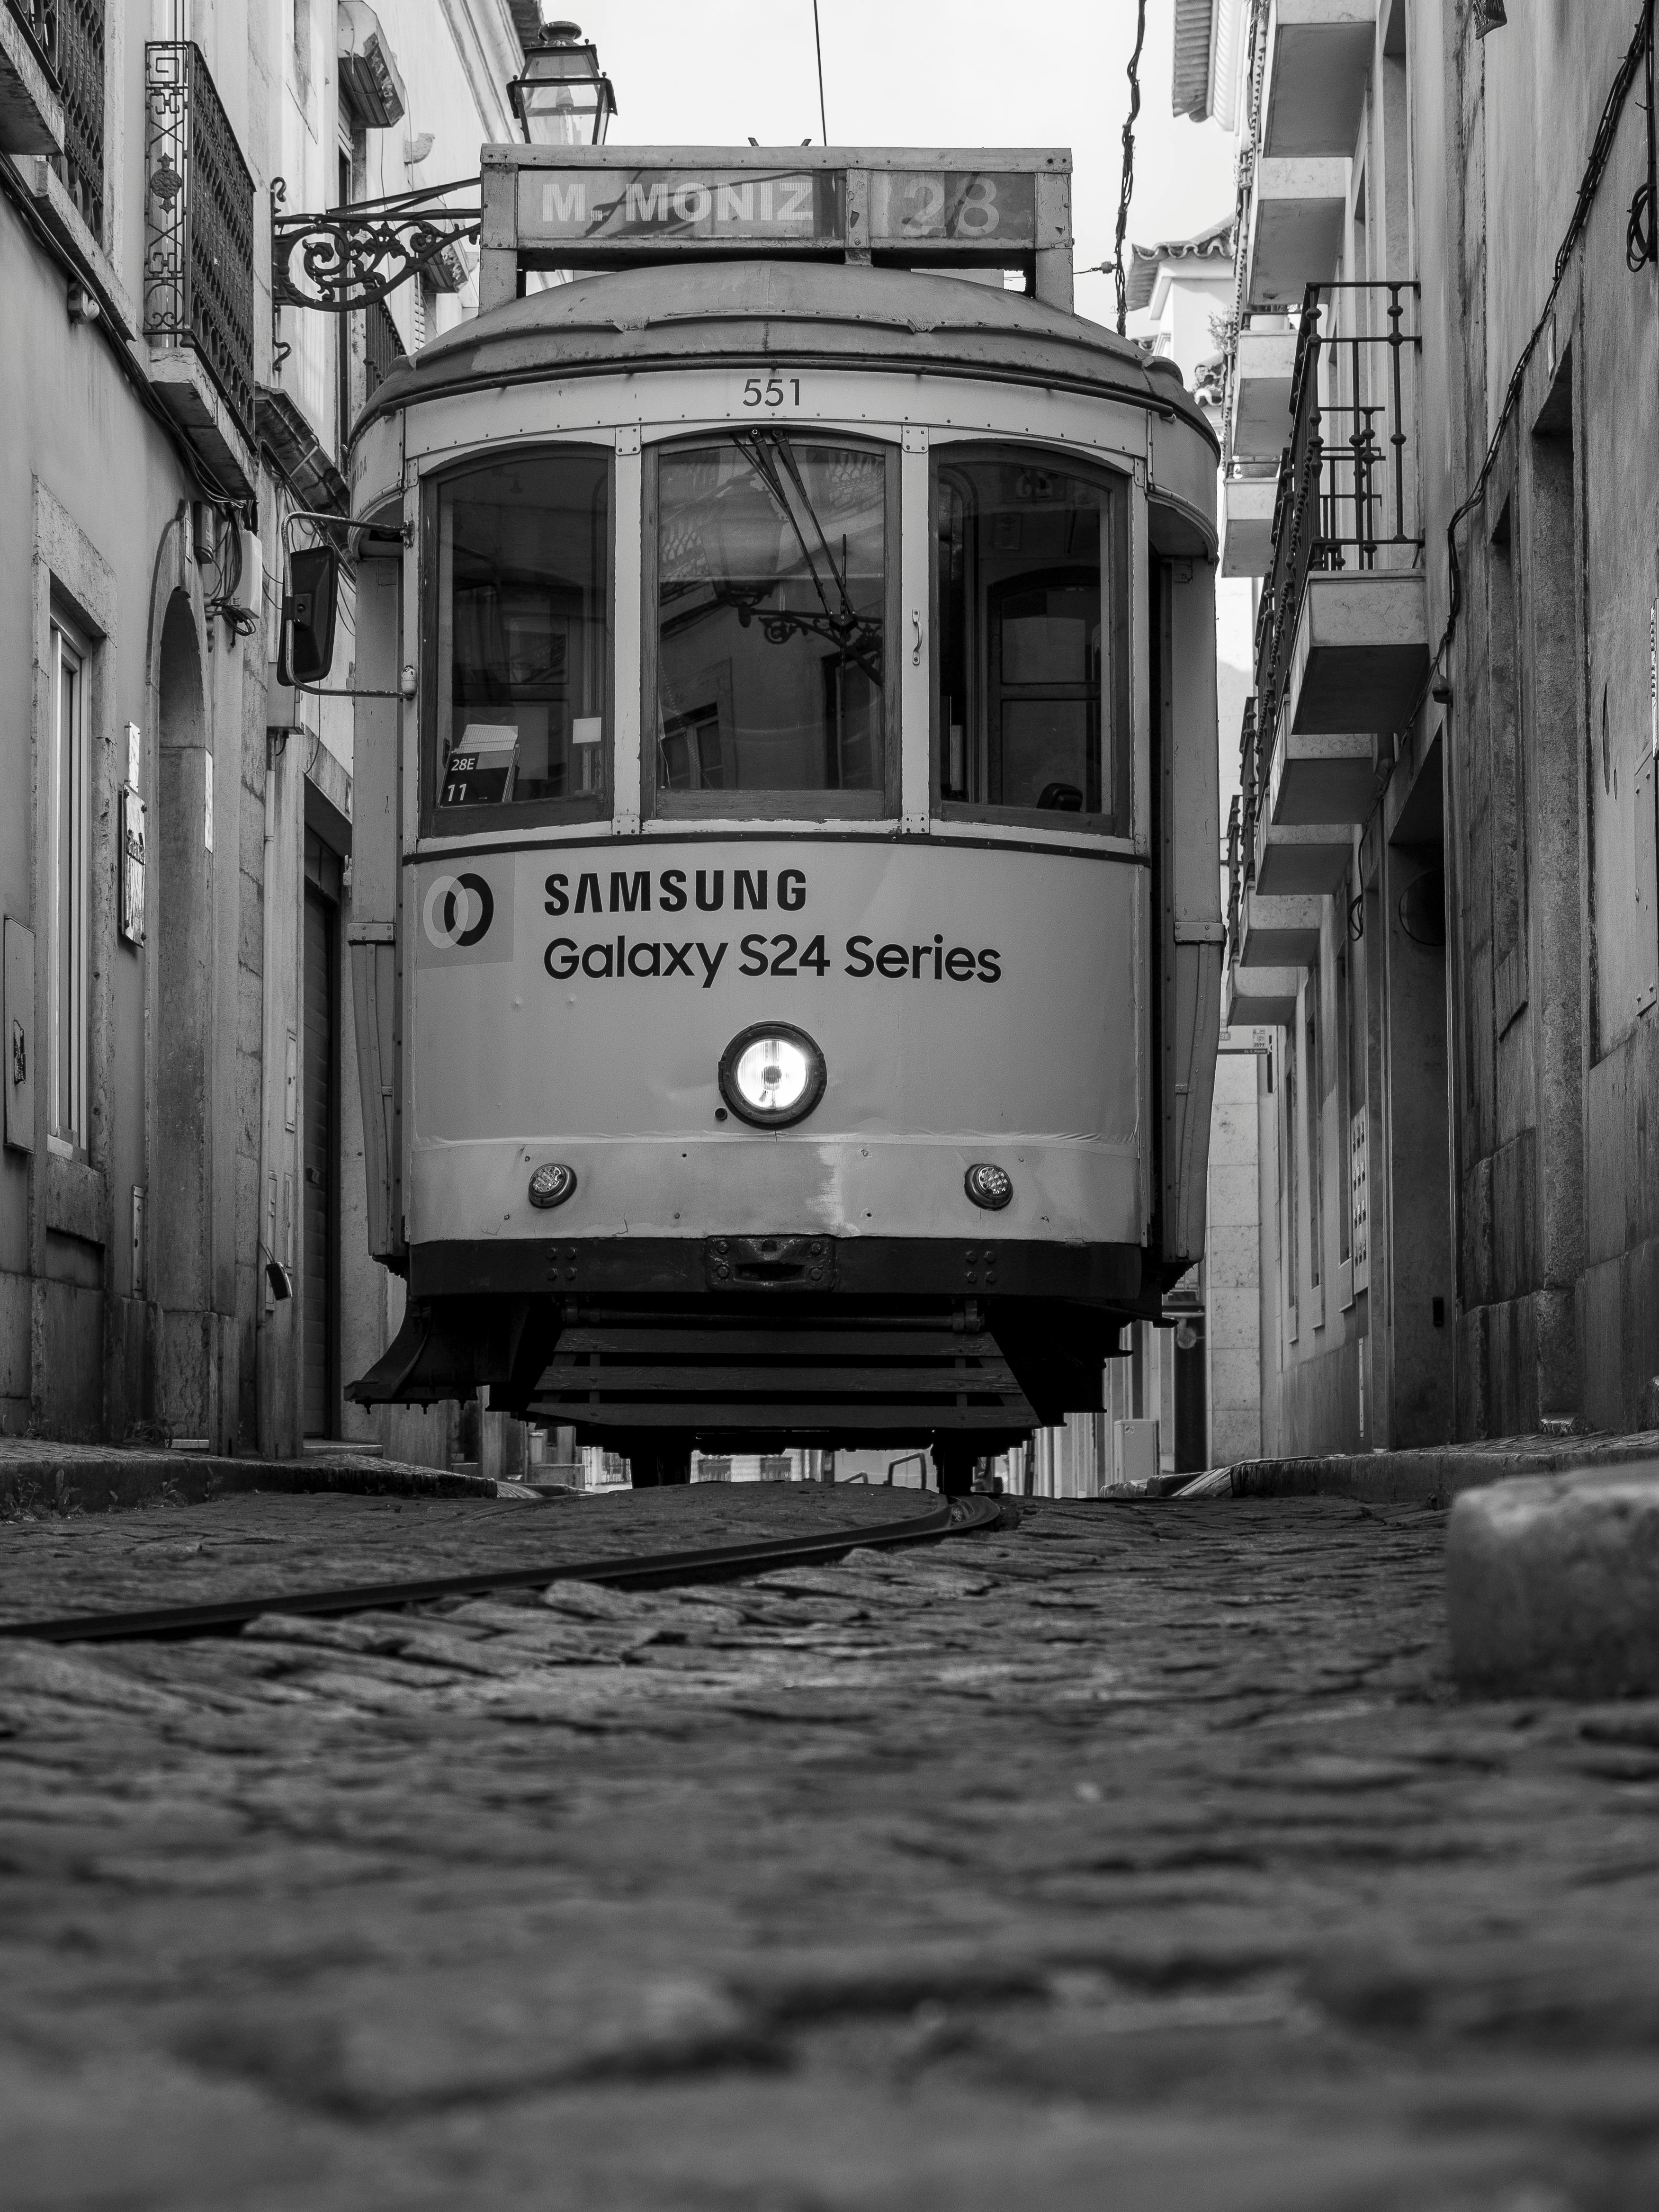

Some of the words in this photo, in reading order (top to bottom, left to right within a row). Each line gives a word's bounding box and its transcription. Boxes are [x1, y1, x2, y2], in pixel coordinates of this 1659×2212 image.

[542, 183, 603, 222] M.
[625, 182, 814, 222] MONIZ
[903, 176, 1000, 237] 28
[743, 378, 800, 406] 551
[451, 758, 475, 771] 28E
[448, 783, 467, 802] 11
[545, 869, 806, 915] SAMSUNG
[544, 936, 728, 988] Galaxy
[739, 934, 830, 976] S24
[844, 934, 1001, 983] Series
